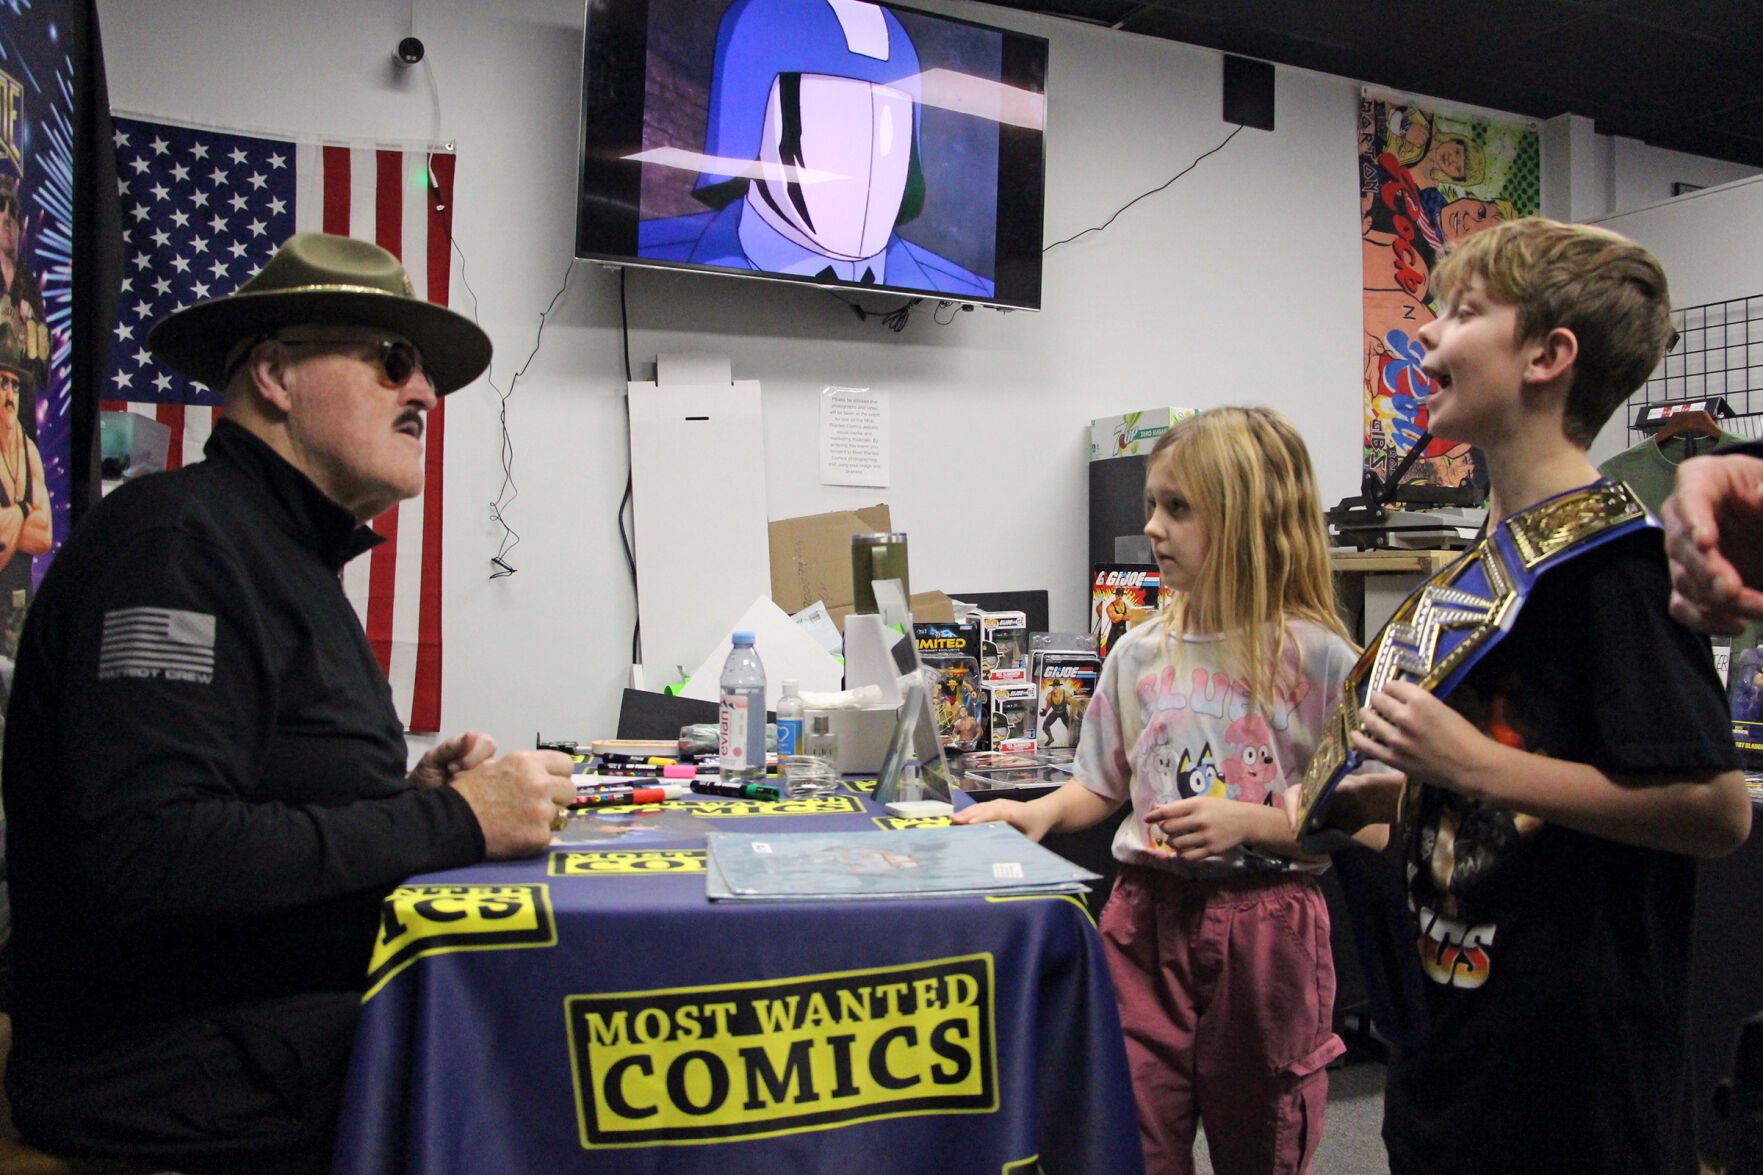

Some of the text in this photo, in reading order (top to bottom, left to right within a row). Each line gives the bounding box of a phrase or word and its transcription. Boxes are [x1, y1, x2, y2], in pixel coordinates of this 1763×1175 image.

[916, 638, 967, 650] IMITED
[721, 710, 729, 757] evian
[382, 897, 523, 946] ICS
[584, 973, 979, 1047] MOST WANTED
[603, 1017, 973, 1120] COMICS
